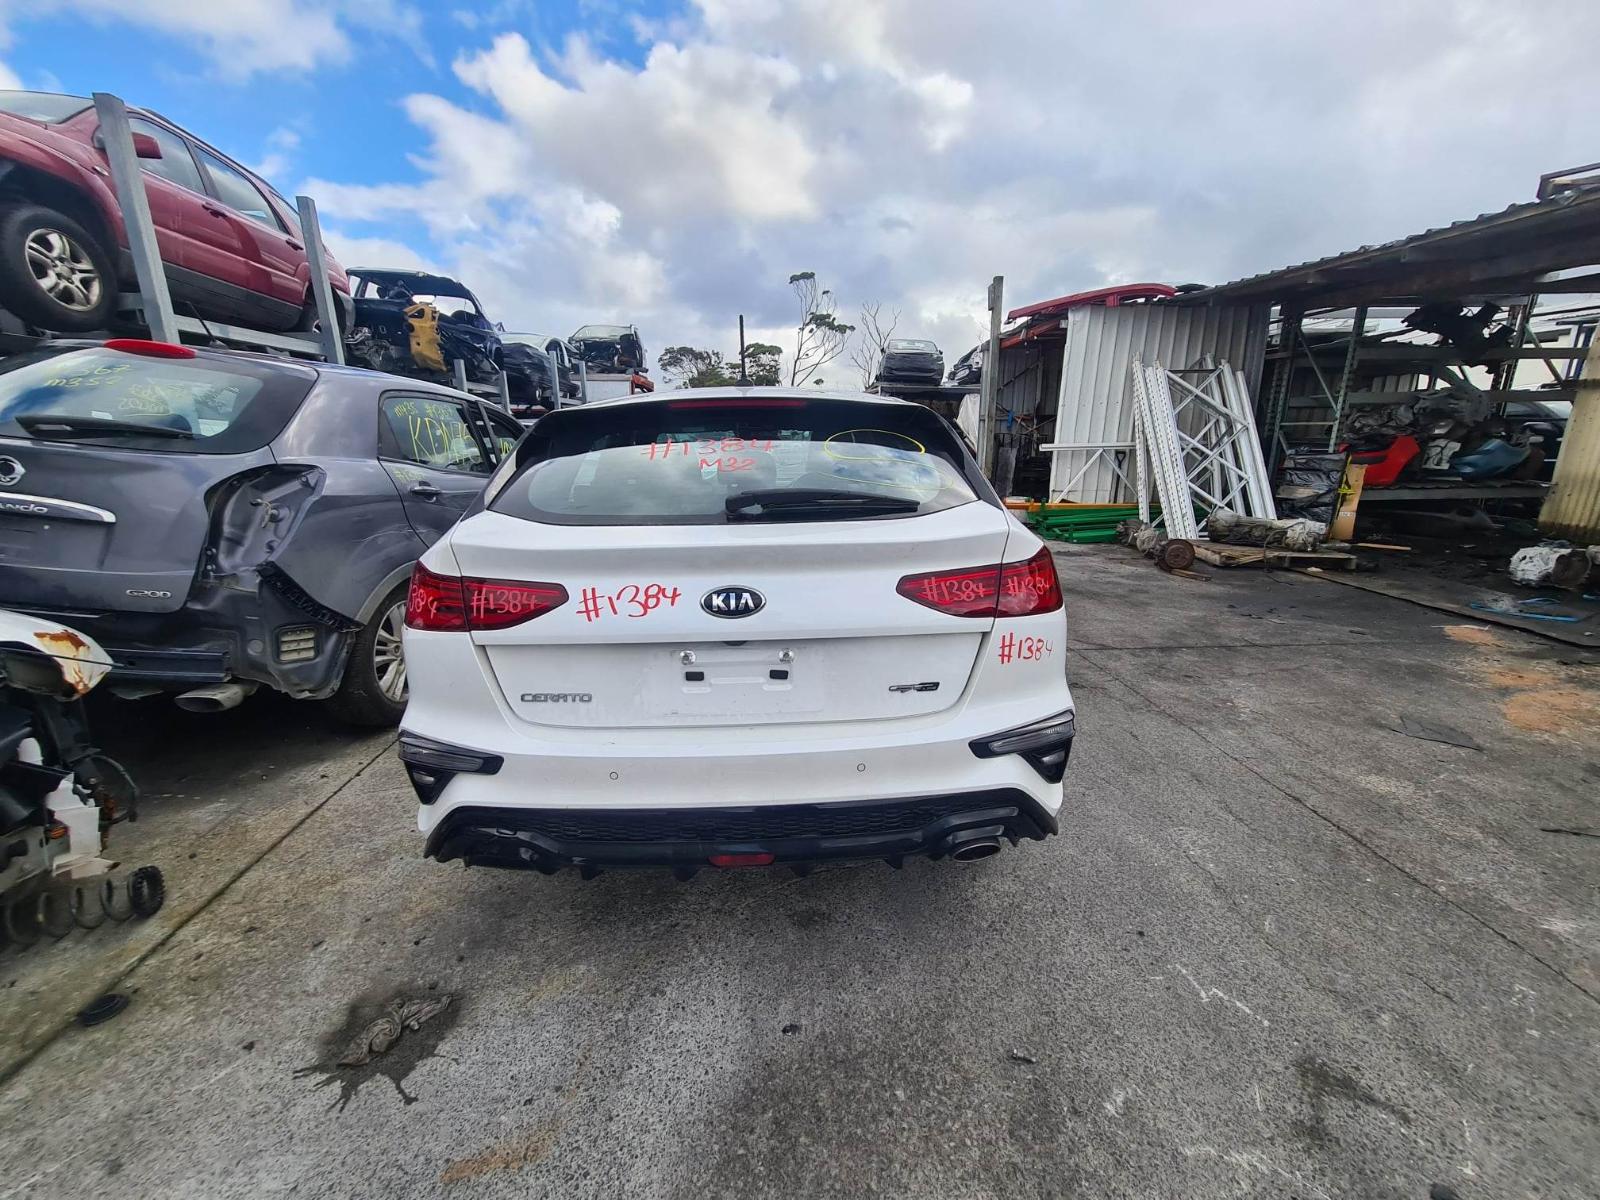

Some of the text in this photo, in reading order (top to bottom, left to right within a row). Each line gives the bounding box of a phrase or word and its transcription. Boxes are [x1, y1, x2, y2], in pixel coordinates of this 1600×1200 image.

[470, 586, 538, 619] #1384
[576, 583, 681, 622] #1384
[711, 592, 755, 611] KIA
[921, 576, 987, 603] #1384
[997, 632, 1054, 665] #1384
[520, 692, 593, 703] CERATO
